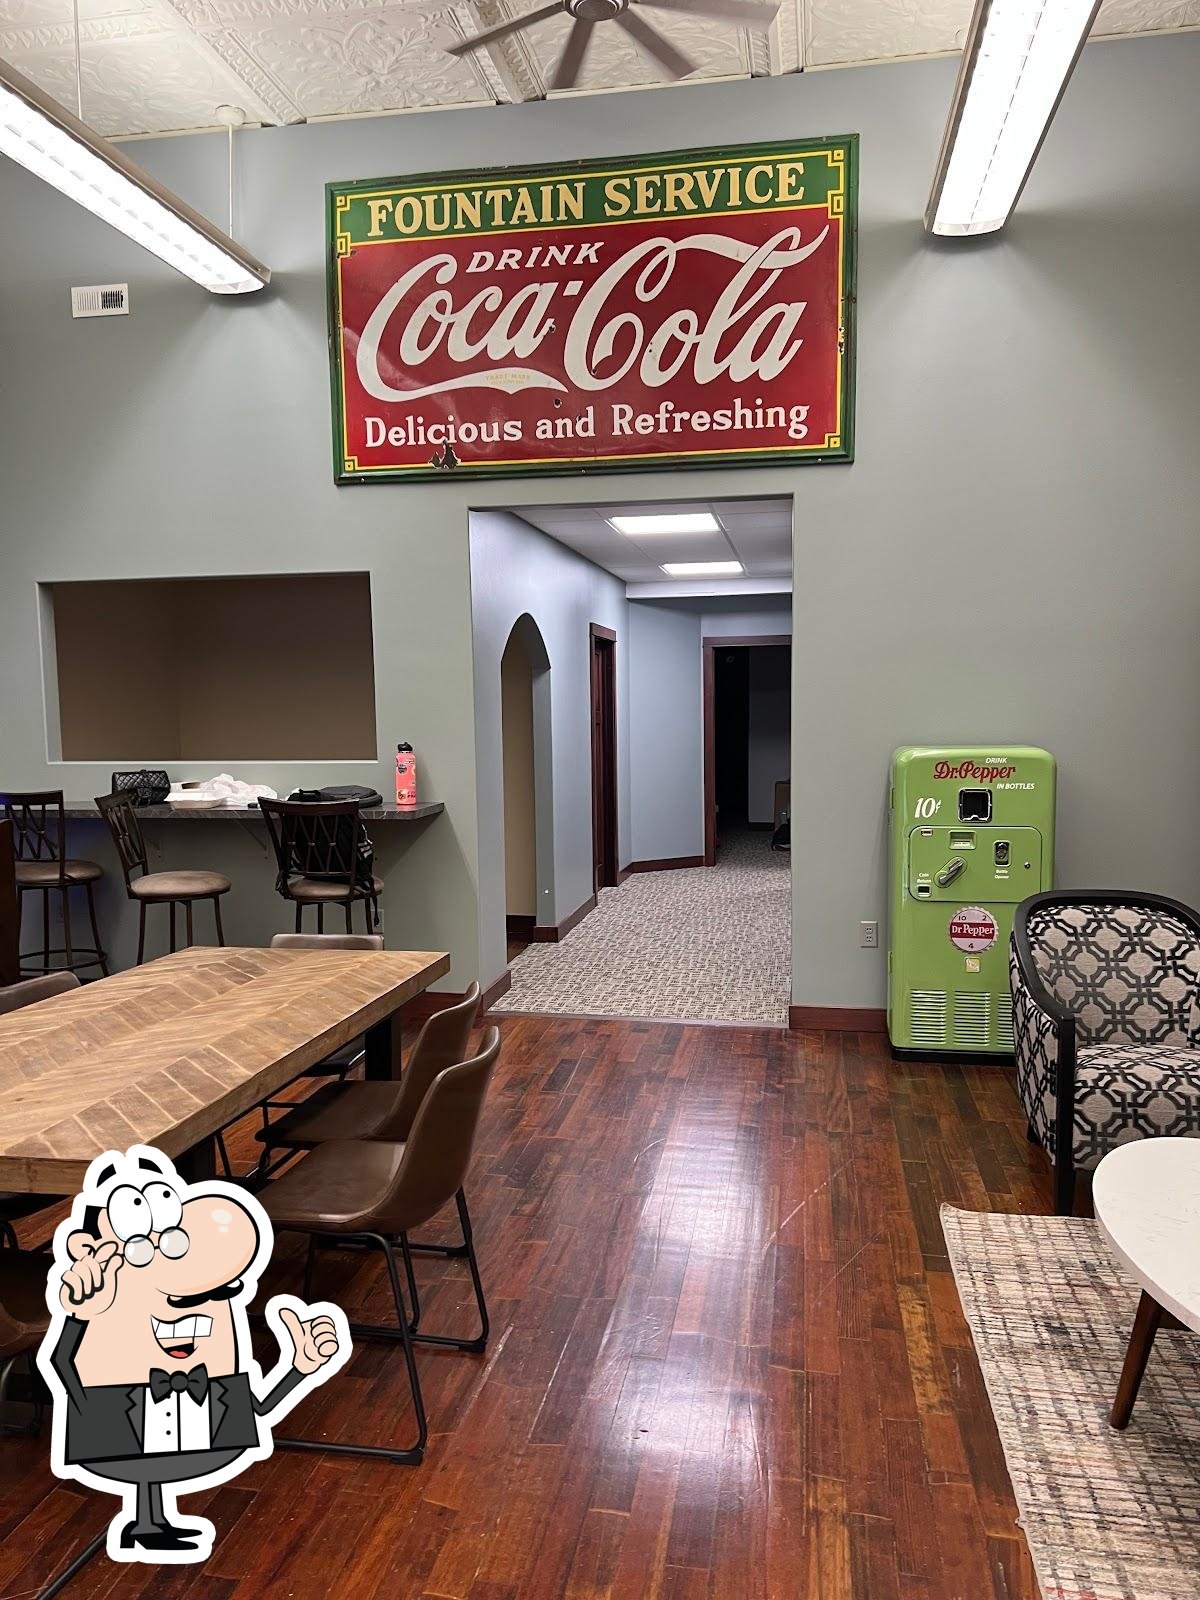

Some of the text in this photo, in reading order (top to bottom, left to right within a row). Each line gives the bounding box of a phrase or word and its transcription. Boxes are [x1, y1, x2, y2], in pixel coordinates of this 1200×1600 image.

[367, 162, 806, 237] FOUNTAIN SERVICE
[466, 241, 605, 273] DRINK
[356, 225, 830, 403] Coca-Cola
[364, 397, 811, 448] Delicious and Refreshing
[952, 923, 995, 937] Dr Pepper
